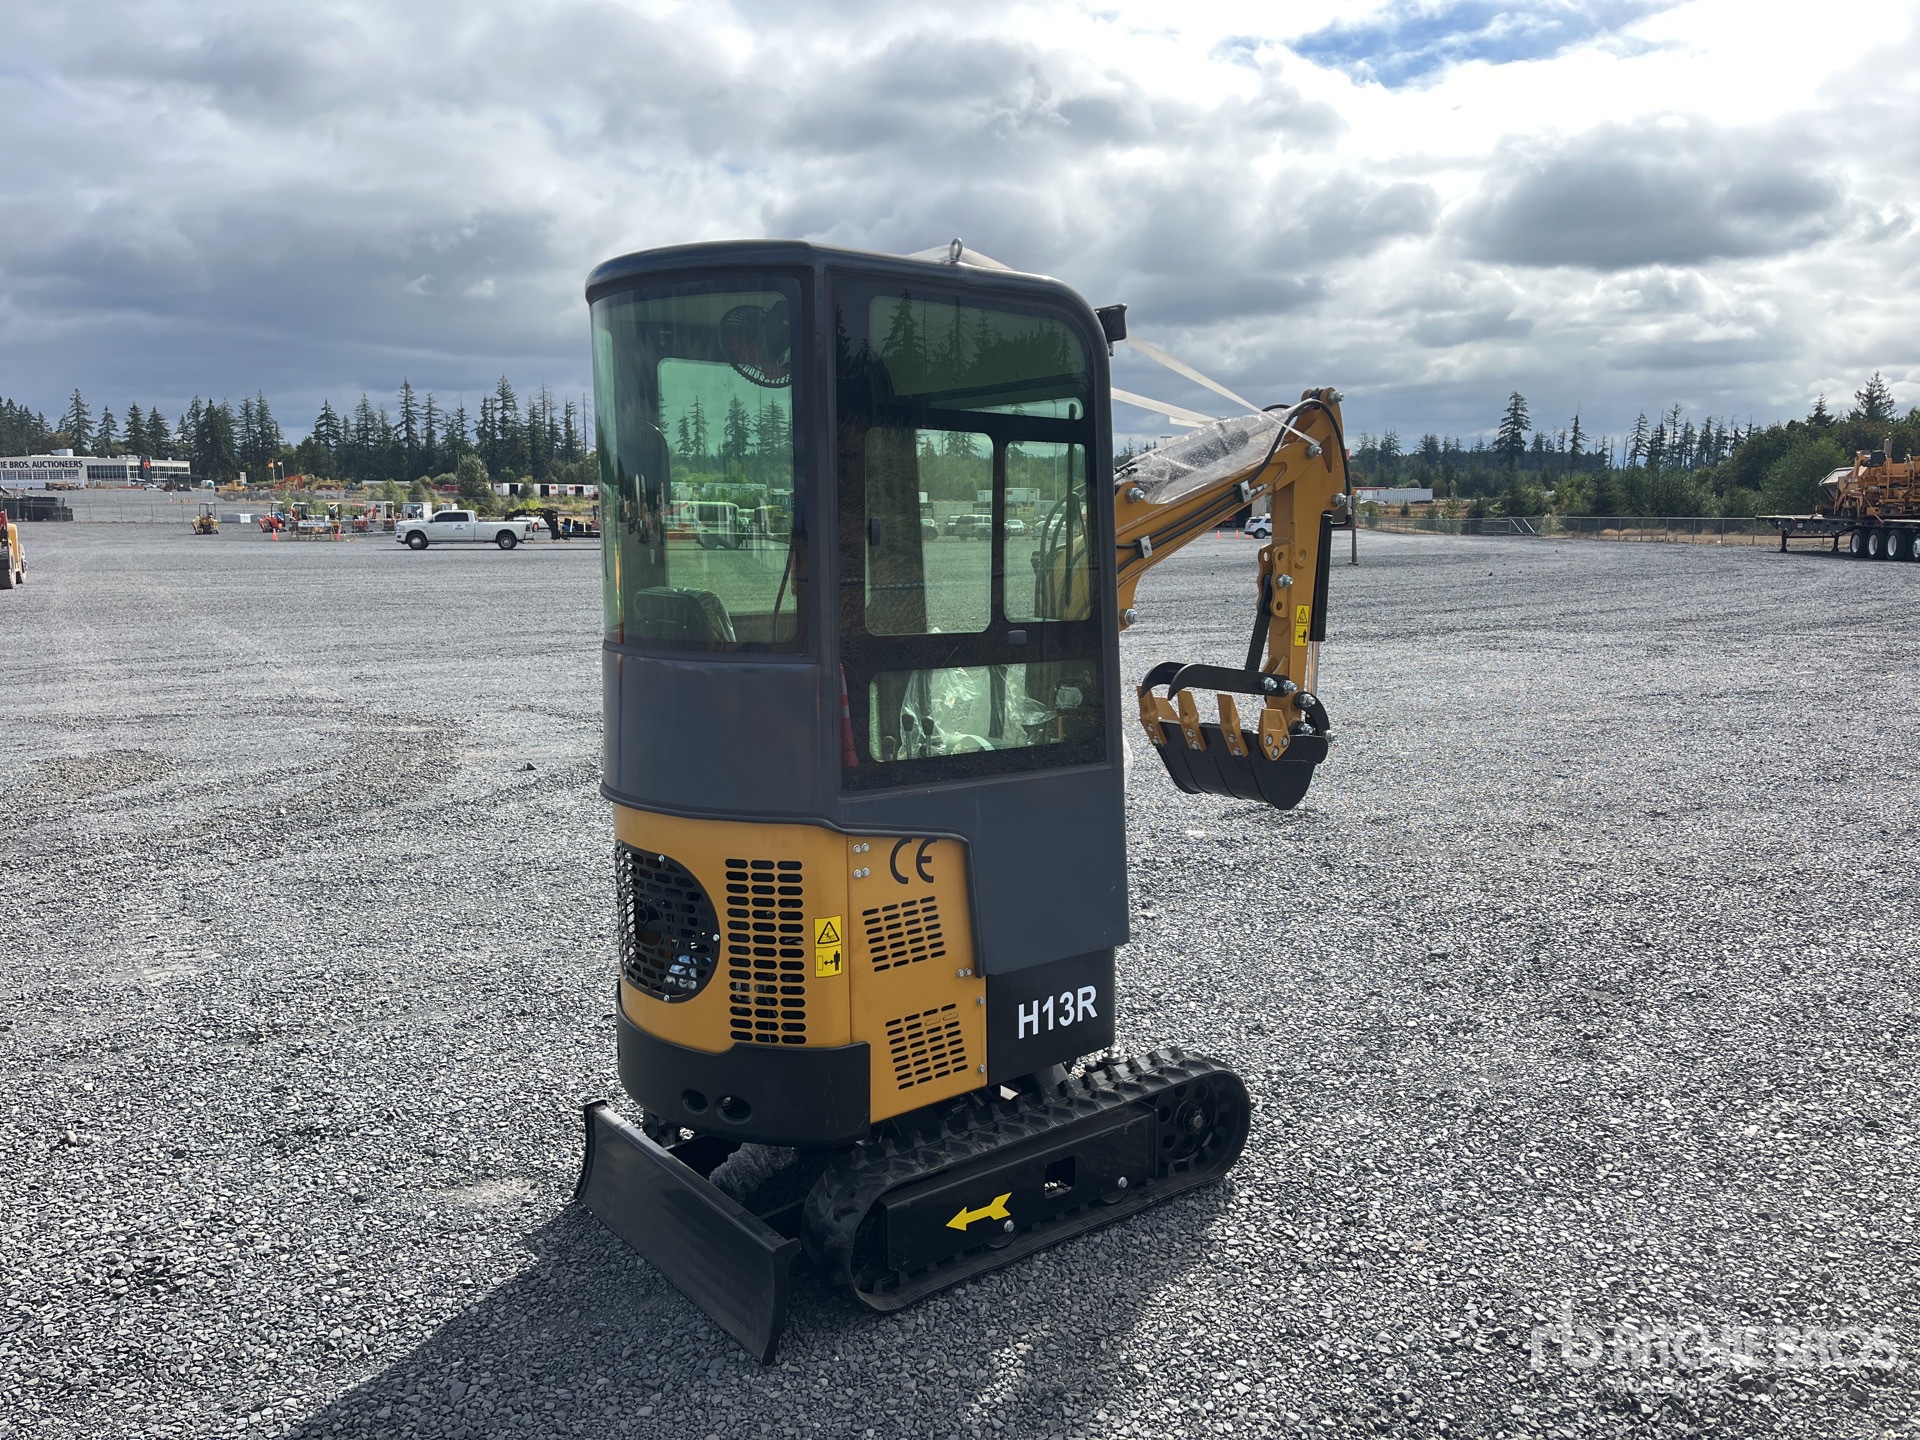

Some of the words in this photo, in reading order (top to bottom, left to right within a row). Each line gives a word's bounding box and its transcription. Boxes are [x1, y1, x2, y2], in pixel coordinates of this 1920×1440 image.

[9, 461, 31, 469] BROS.
[32, 460, 83, 468] AUCTIONEERS
[889, 837, 938, 885] CE
[1018, 985, 1098, 1040] H13R
